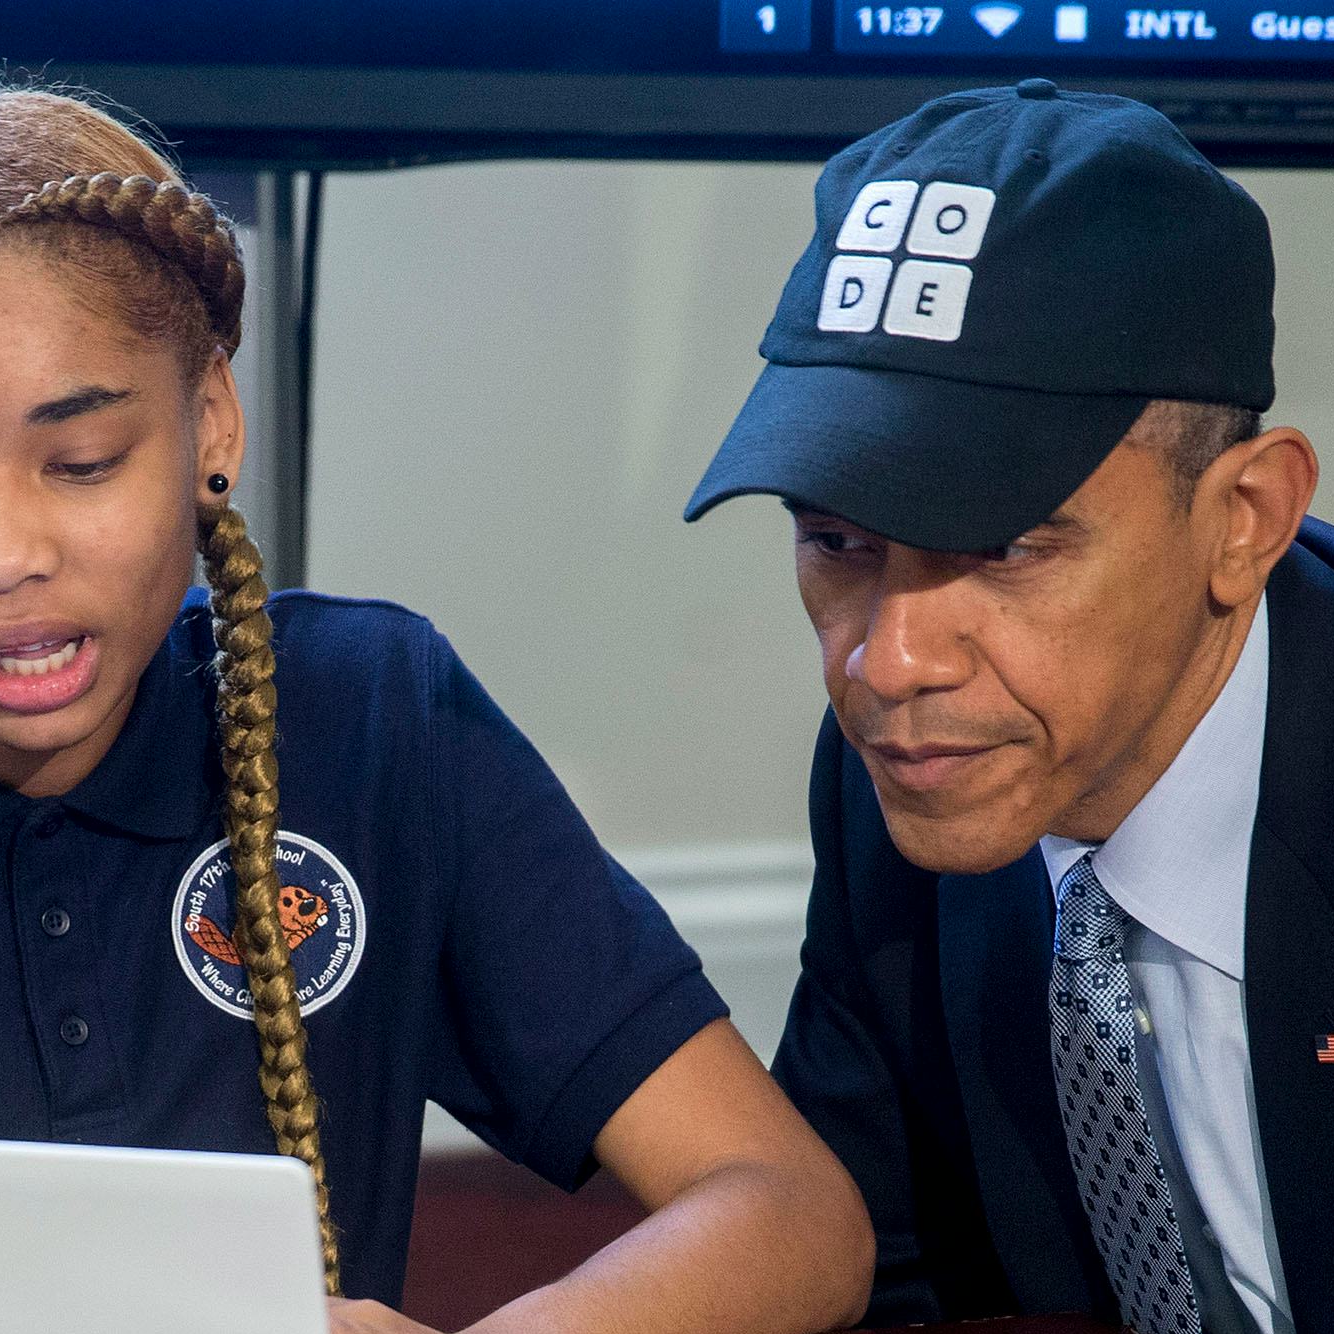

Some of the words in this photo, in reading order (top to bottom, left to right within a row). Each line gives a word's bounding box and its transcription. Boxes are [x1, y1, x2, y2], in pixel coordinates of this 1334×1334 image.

[755, 4, 777, 35] 1
[857, 6, 945, 37] 11:37
[1125, 9, 1218, 40] INTL
[184, 890, 208, 932] South
[199, 859, 232, 889] 17th
[275, 845, 307, 866] hool
[310, 941, 352, 989] Learning
